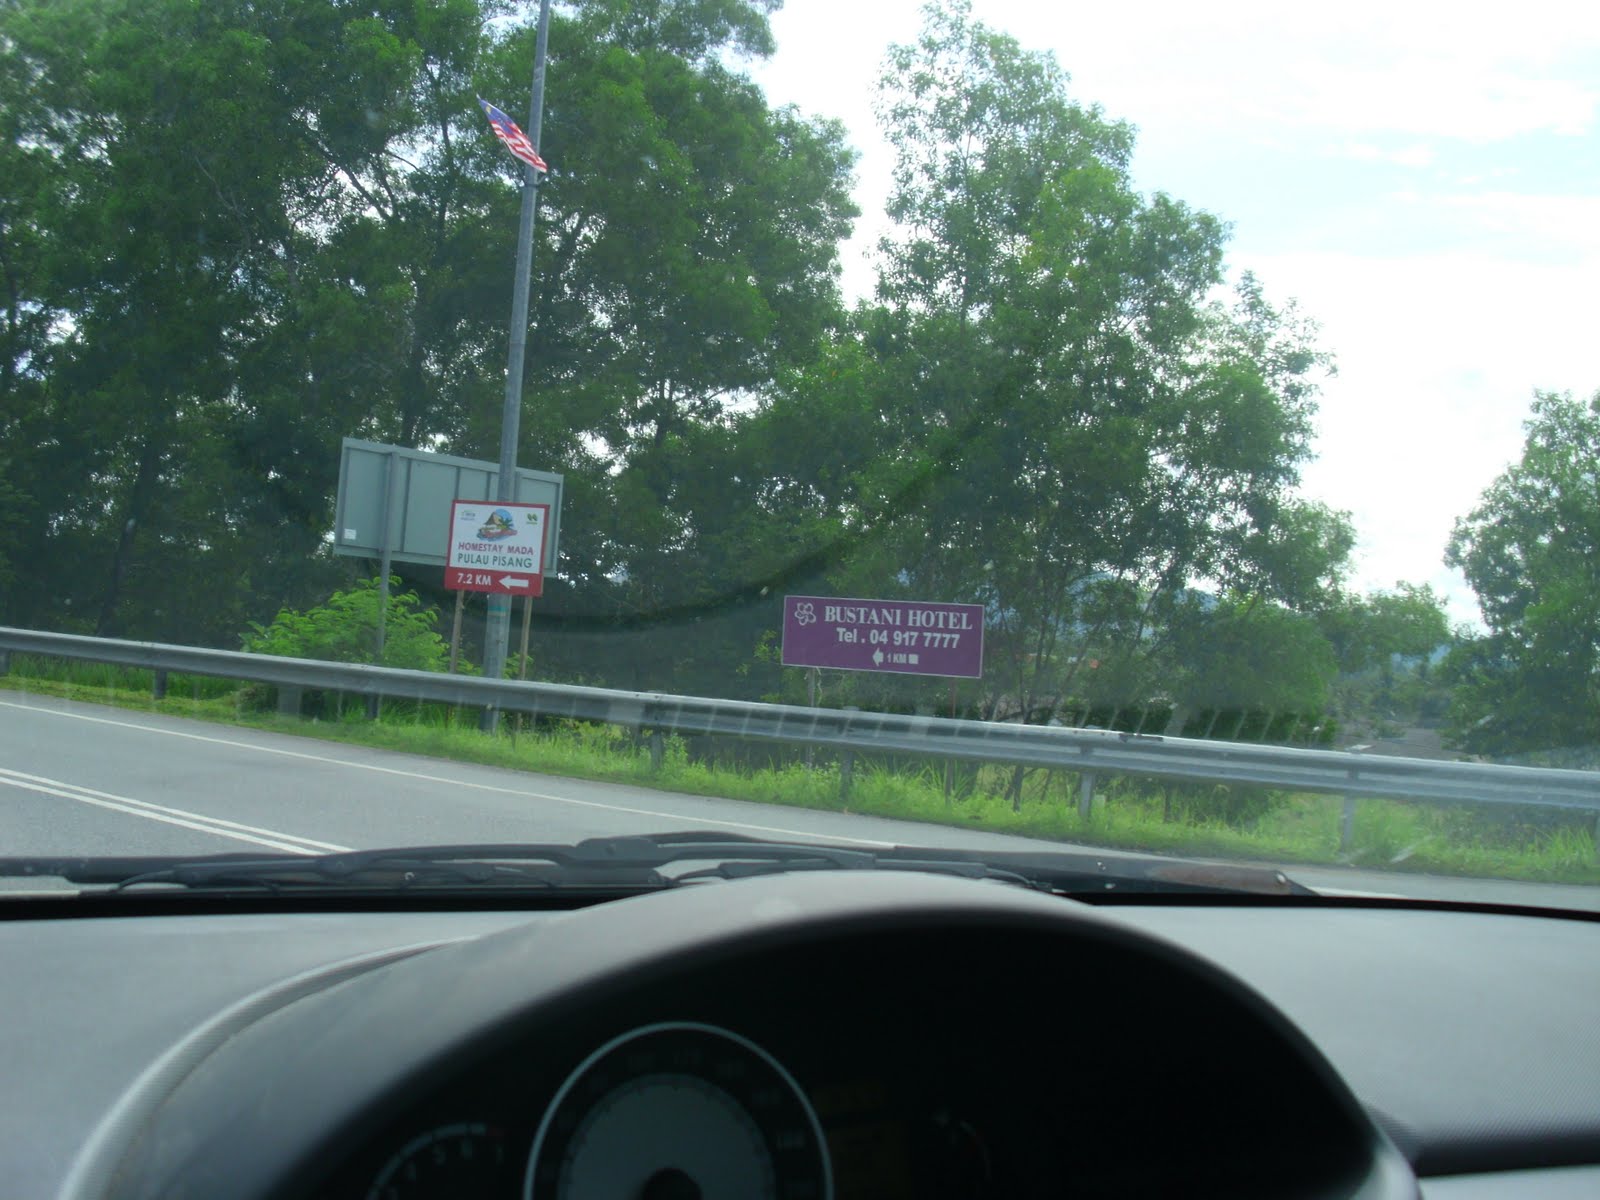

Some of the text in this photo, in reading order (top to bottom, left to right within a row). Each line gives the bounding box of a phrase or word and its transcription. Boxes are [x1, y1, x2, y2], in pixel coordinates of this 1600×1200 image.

[458, 542, 534, 555] HOMESTAY MADA
[457, 553, 533, 568] PULAU PISANG
[457, 573, 492, 586] 7.2 KM
[824, 605, 972, 630] BUSTANI HOTEL
[869, 629, 888, 644] 04
[893, 630, 918, 647] 917
[923, 632, 960, 649] 7777
[886, 653, 907, 665] 1 KM
